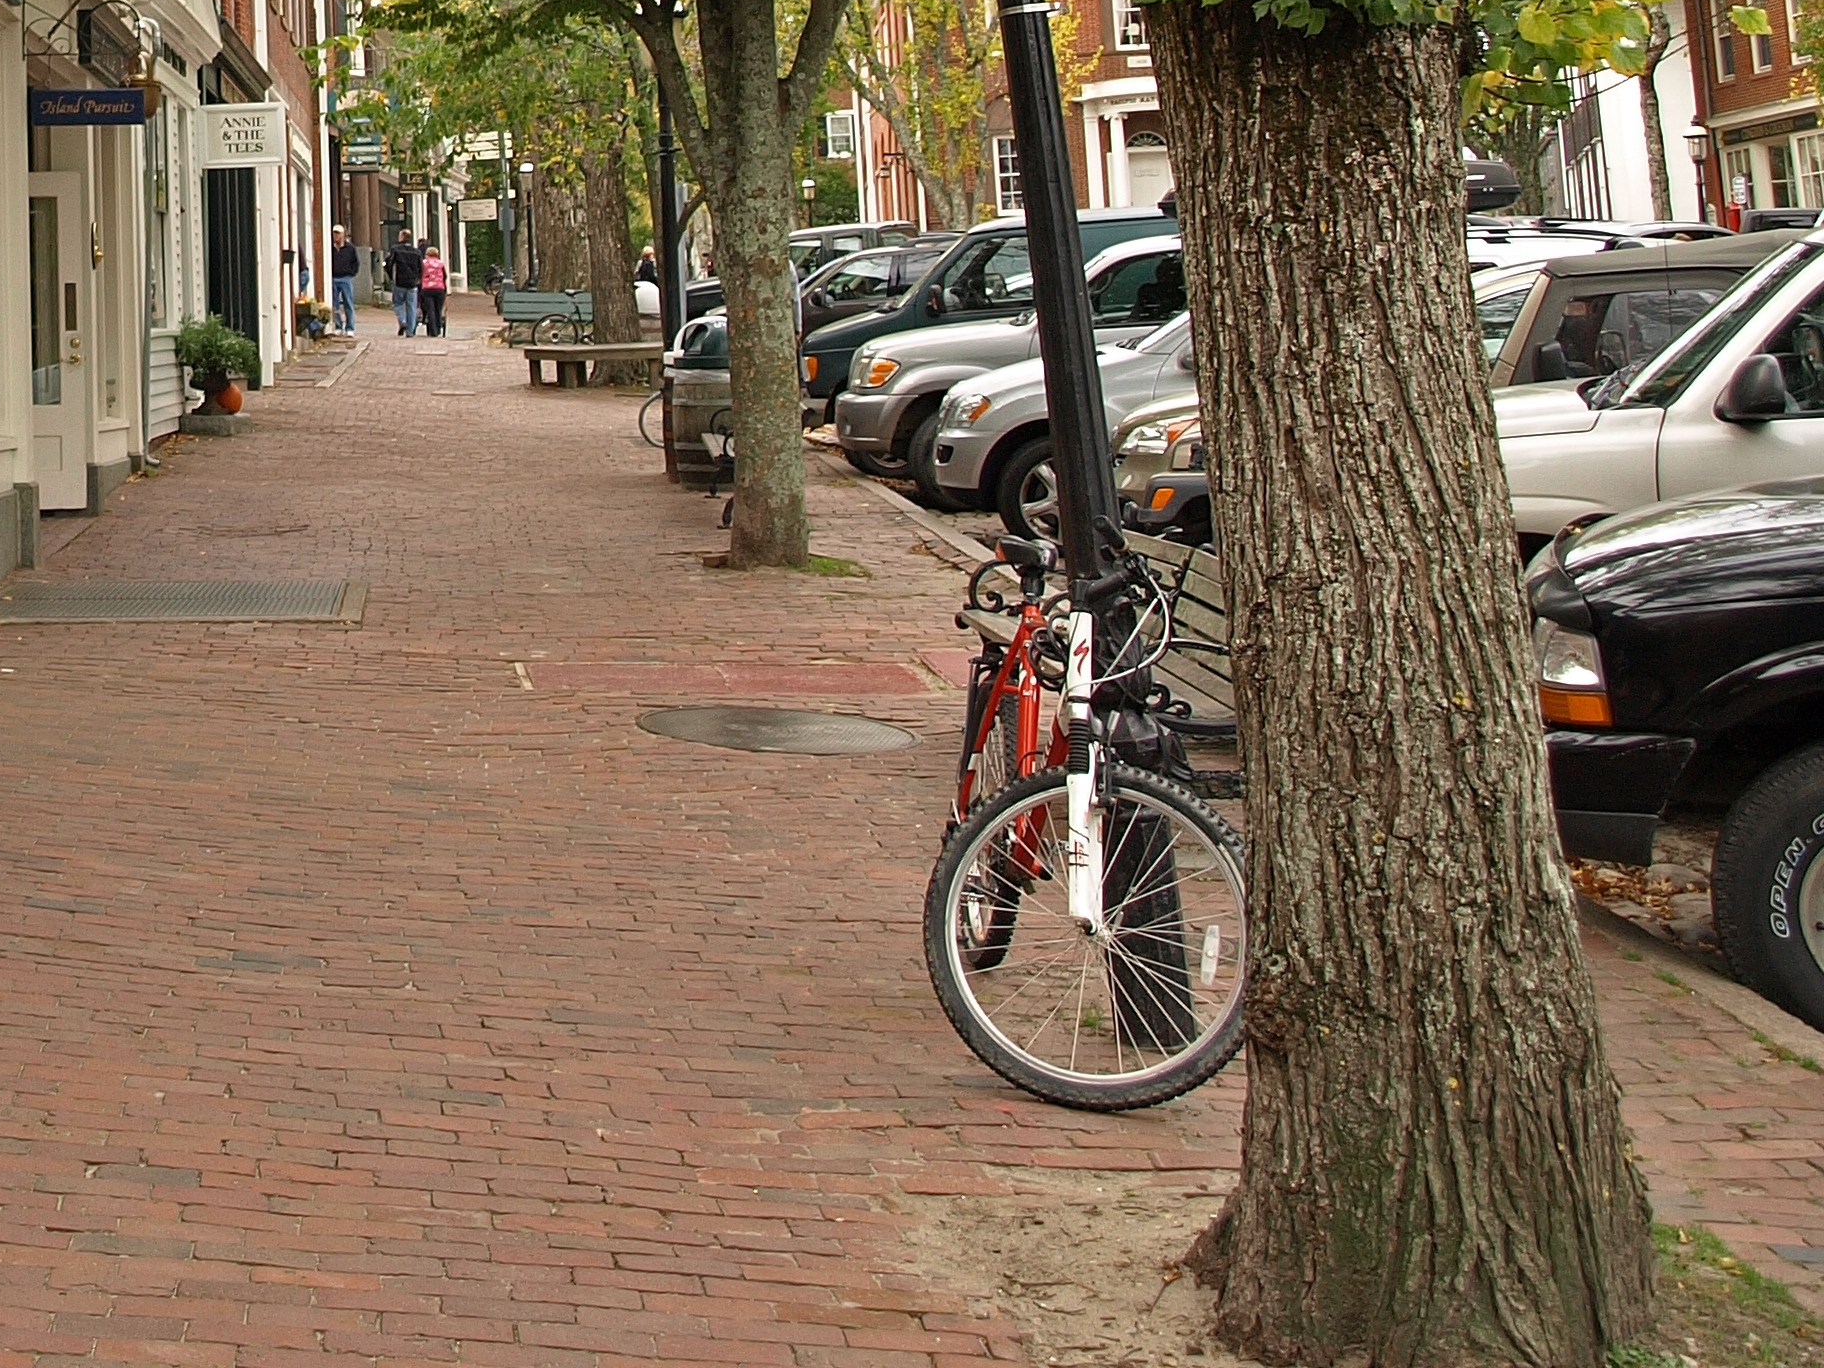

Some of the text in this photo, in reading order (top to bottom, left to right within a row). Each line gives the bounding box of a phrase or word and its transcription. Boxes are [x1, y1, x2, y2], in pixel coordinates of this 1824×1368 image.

[40, 96, 83, 114] Island
[220, 117, 267, 128] ANNIE
[222, 129, 266, 140] & THE
[225, 143, 264, 153] TEES
[1770, 837, 1806, 938] OPEN
